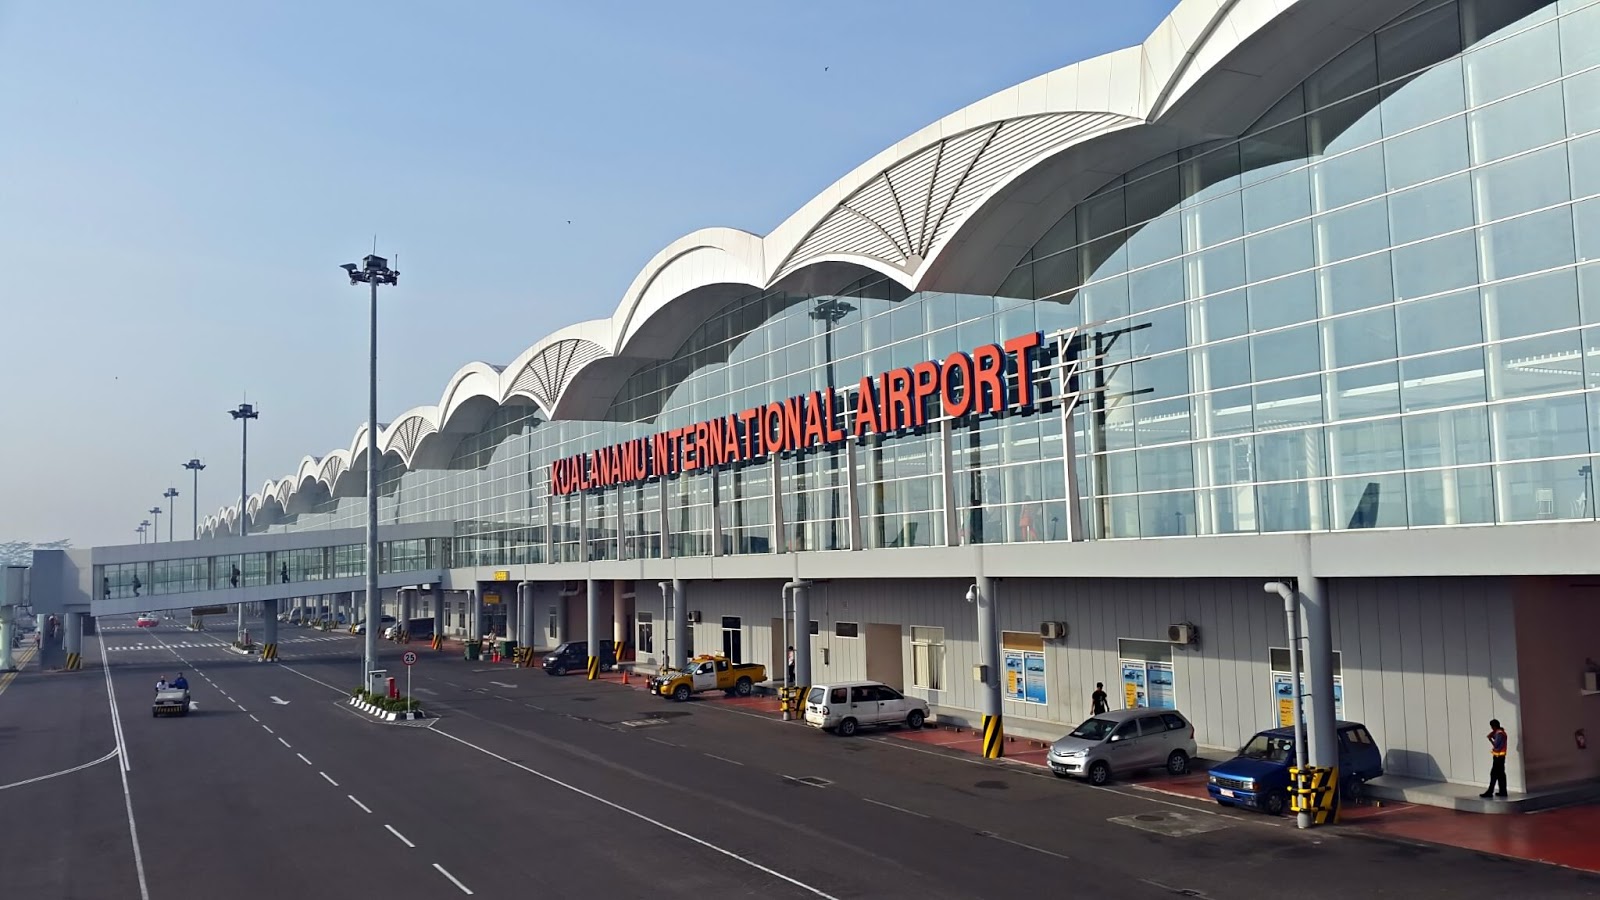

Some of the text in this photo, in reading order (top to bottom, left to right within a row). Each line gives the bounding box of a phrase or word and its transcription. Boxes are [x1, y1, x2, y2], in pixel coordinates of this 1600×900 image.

[551, 330, 1043, 496] KUALANAMU INTERNATIONAL AIRPORT
